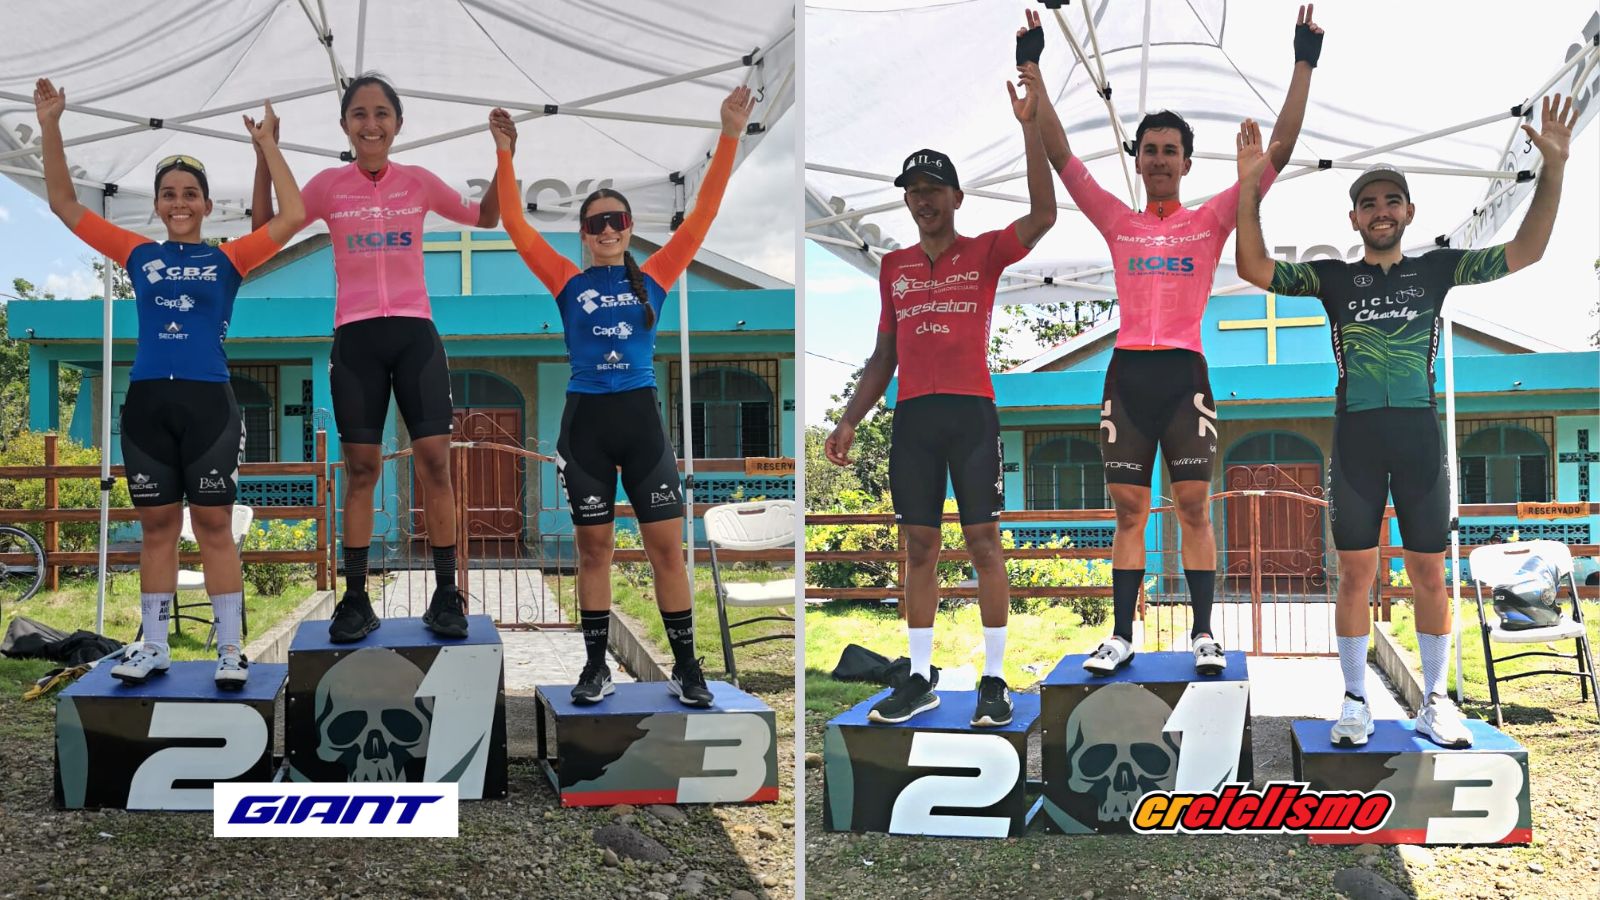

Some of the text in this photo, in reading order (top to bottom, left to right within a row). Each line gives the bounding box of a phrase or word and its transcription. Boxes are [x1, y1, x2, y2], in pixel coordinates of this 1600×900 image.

[387, 206, 423, 217] CYCLING
[346, 231, 413, 249] ROES
[1117, 230, 1211, 244] PIRATE CYCLING
[165, 265, 218, 276] CBZ
[1128, 256, 1195, 272] ROES
[911, 270, 979, 289] COLONO
[600, 293, 639, 303] CB
[896, 299, 977, 322] bikestation
[1355, 307, 1420, 322] Charly
[596, 363, 630, 371] SECNET
[1105, 461, 1144, 471] FORCE
[199, 477, 227, 489] B&A
[650, 490, 677, 504] B&A
[1528, 506, 1580, 515] RESERVADO
[414, 645, 501, 800] 1
[1161, 681, 1250, 800] 1
[126, 702, 269, 811] 2
[676, 713, 771, 804] 3
[889, 732, 1021, 838] 2
[1425, 753, 1523, 844] 3
